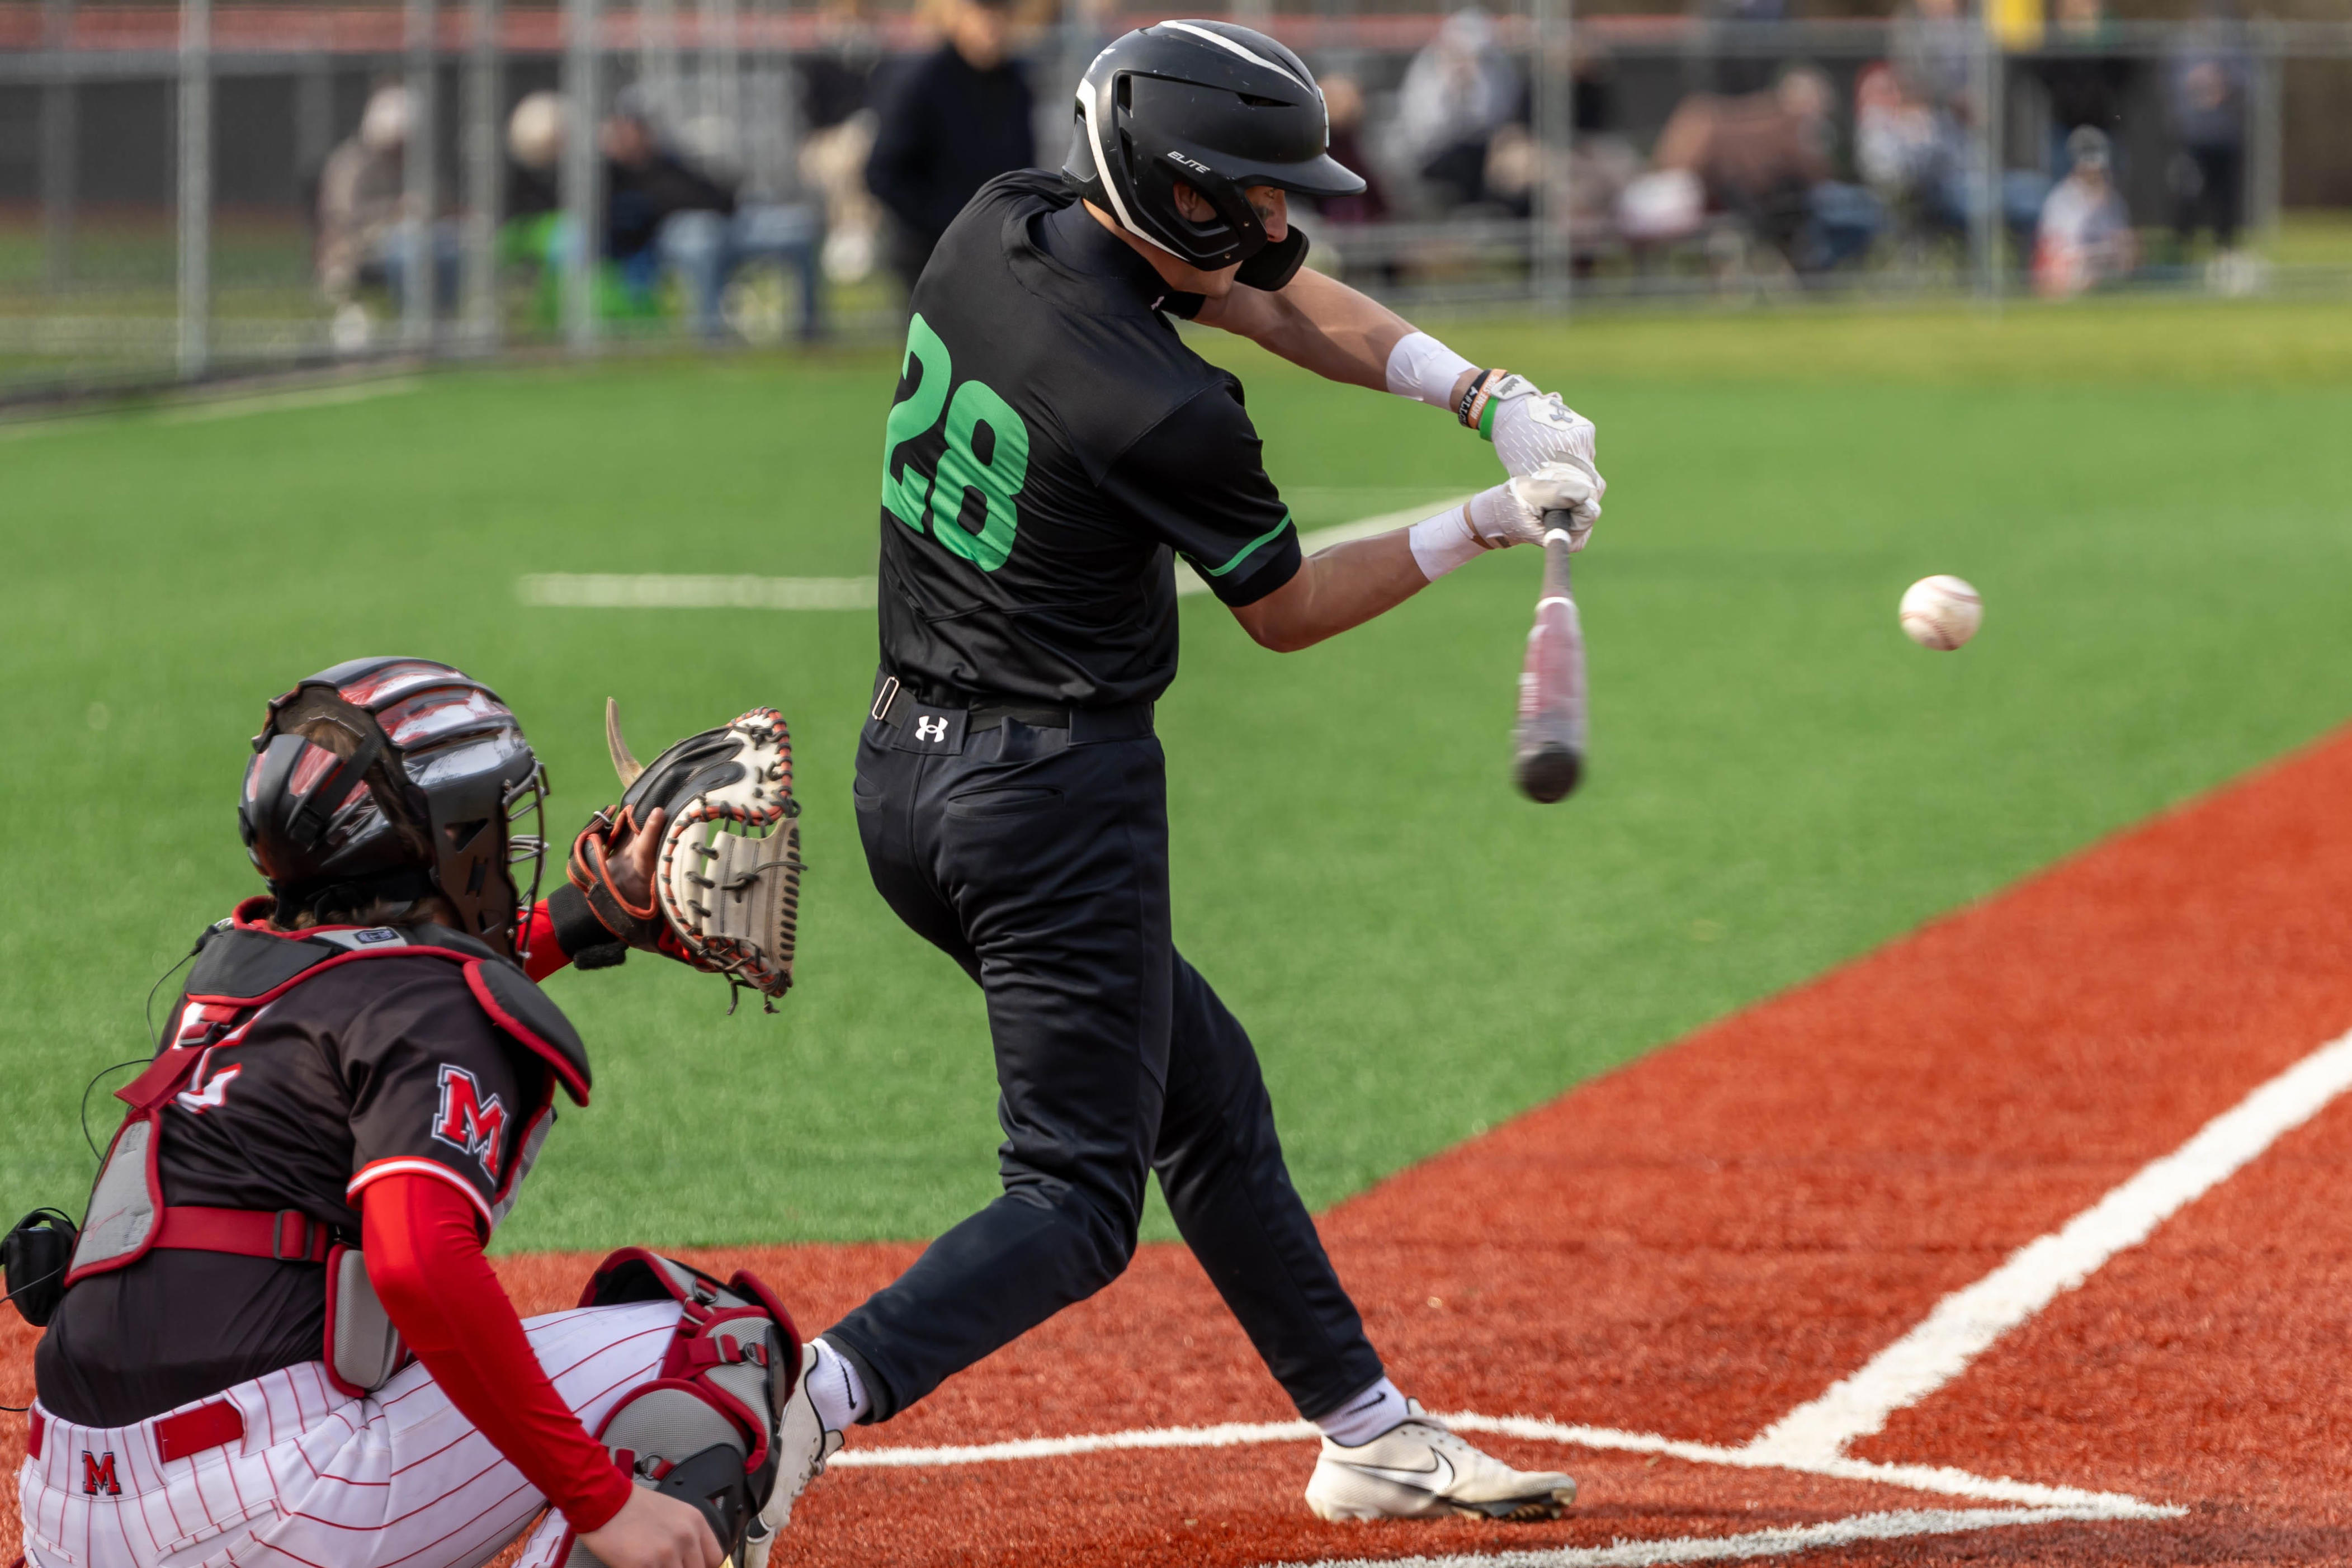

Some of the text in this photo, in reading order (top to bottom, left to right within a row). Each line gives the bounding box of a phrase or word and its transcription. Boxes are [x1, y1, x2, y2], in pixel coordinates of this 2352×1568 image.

[1167, 150, 1211, 173] ELITE
[882, 312, 1029, 572] 28
[431, 1063, 510, 1187] M
[82, 1450, 122, 1496] M
